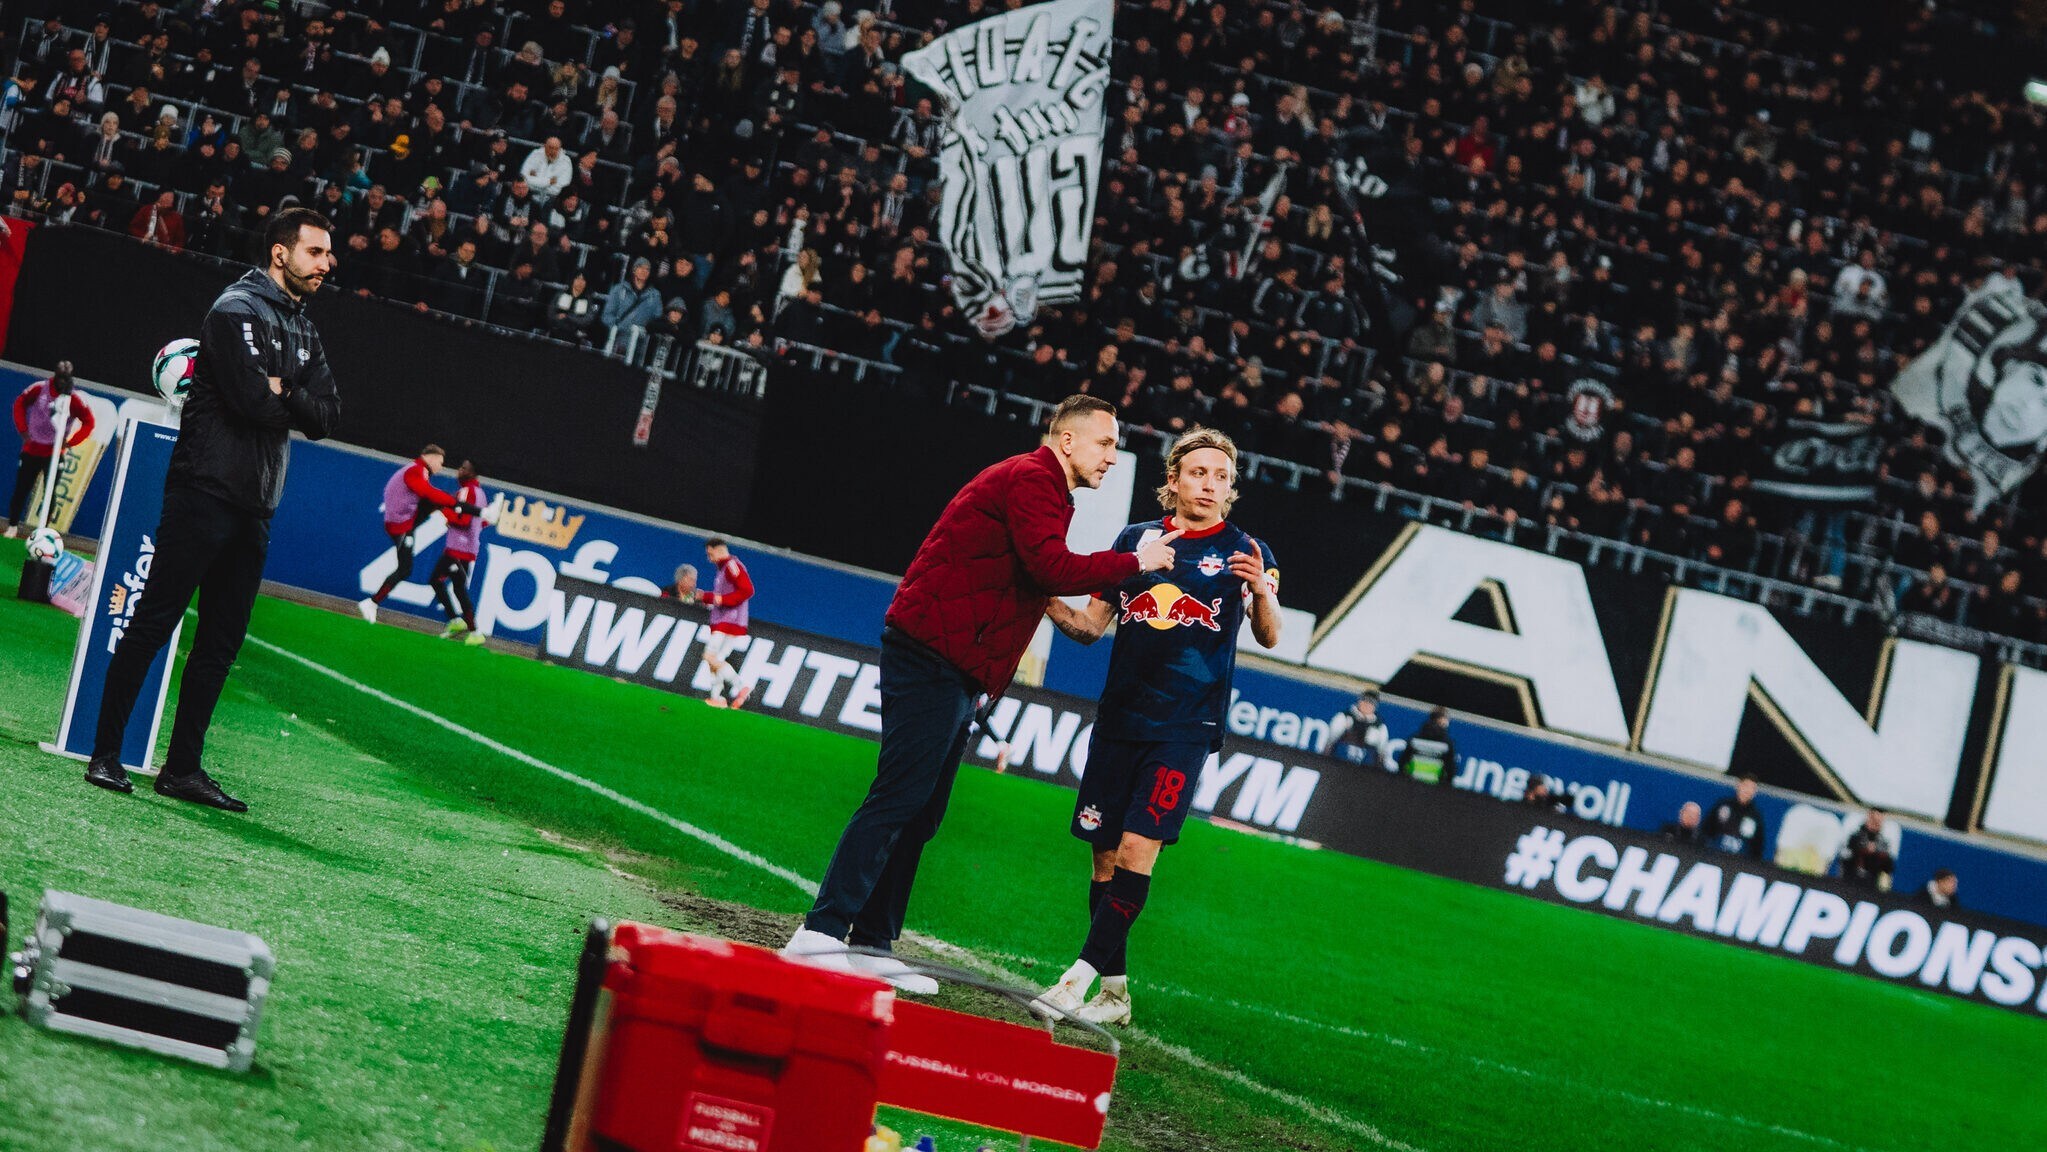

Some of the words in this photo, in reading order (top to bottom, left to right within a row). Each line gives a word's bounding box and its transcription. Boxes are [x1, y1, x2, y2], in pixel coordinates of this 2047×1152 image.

[1149, 766, 1186, 811] 18
[1504, 825, 2047, 1012] #CHAMPIONS
[885, 1050, 970, 1079] FUSSBALL
[976, 1071, 1009, 1087] VON
[1012, 1077, 1087, 1104] MORGEN
